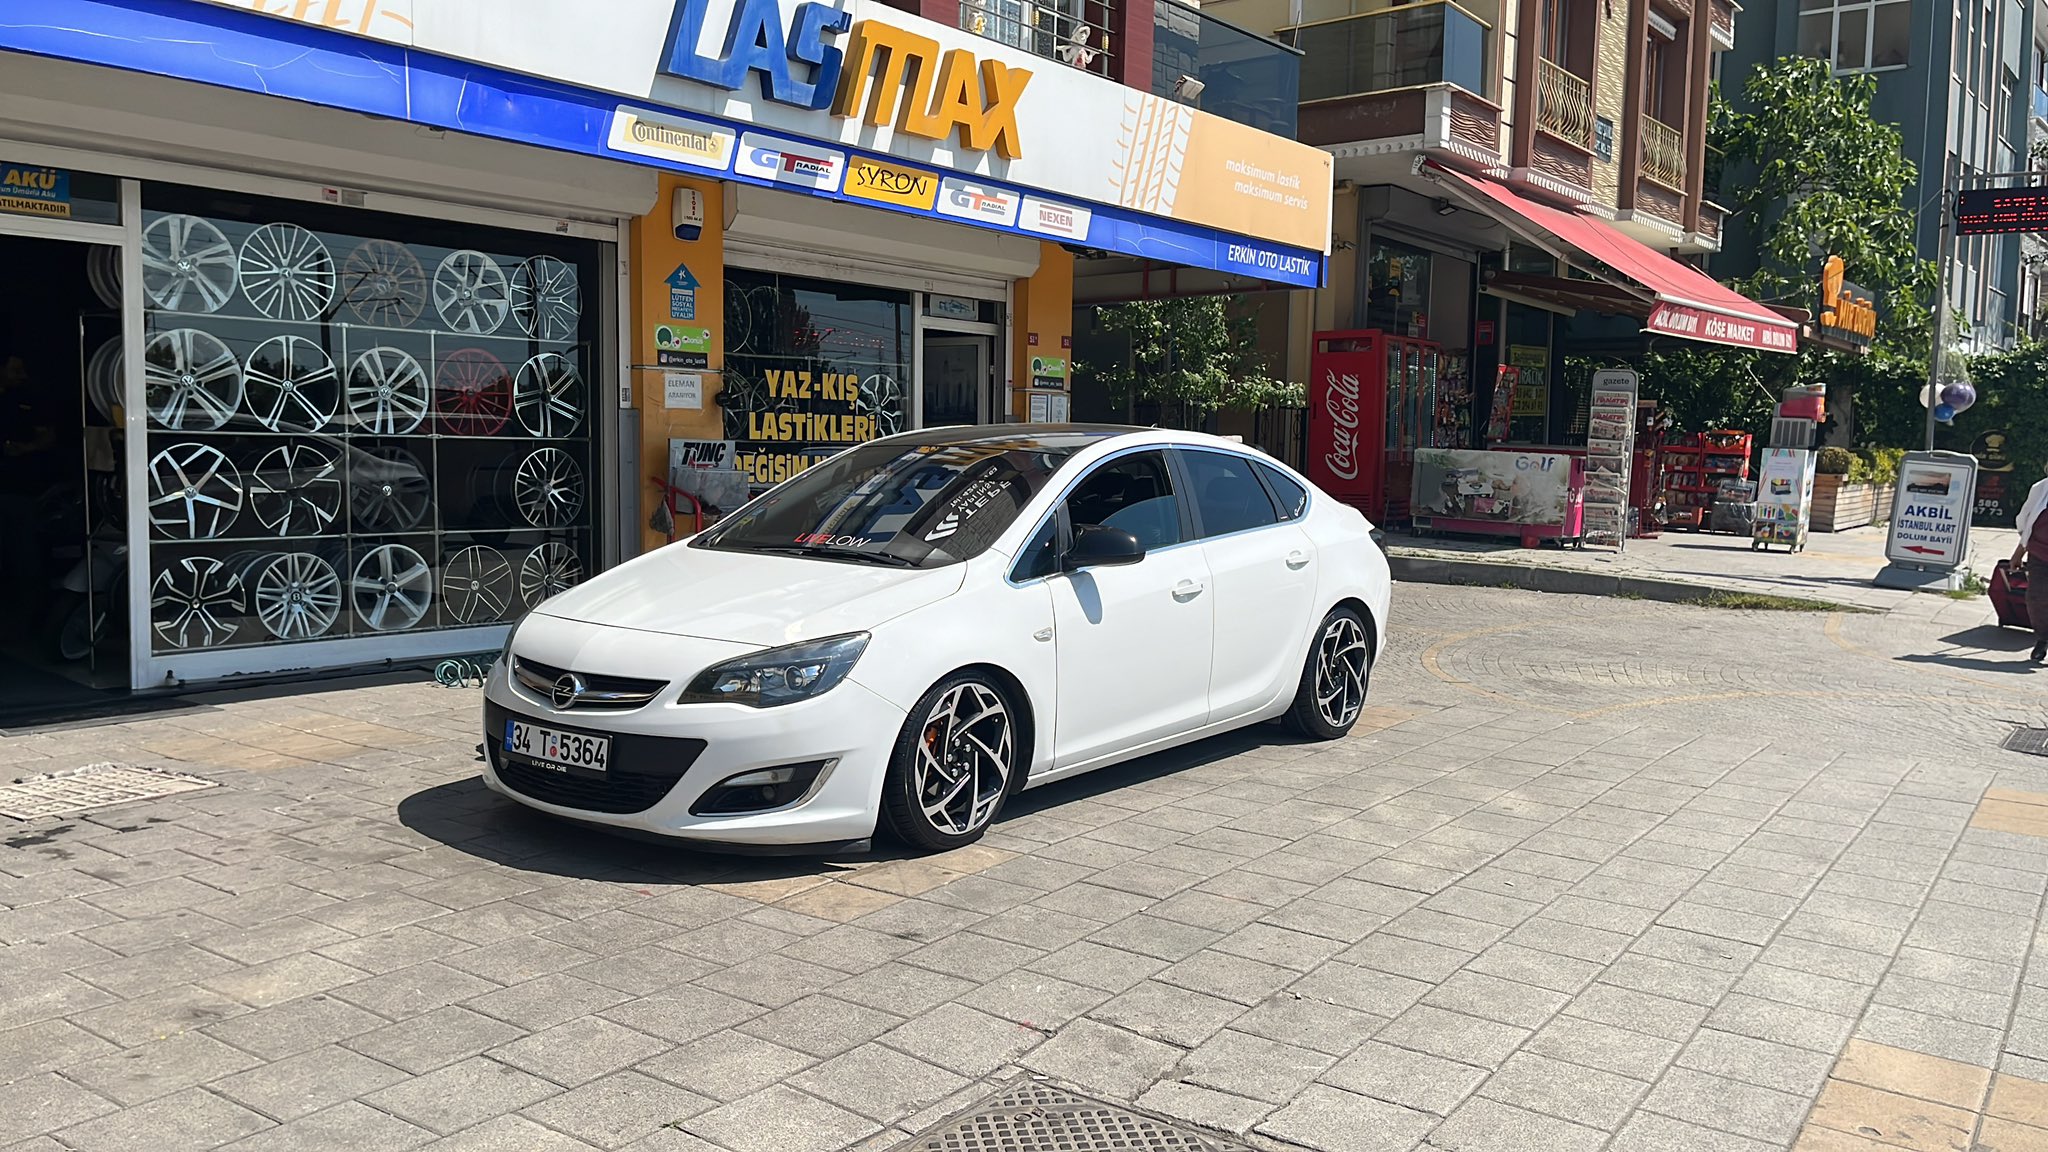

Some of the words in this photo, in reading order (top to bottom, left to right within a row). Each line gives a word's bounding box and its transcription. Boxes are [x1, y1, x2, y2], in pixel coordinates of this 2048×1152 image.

[655, 0, 1033, 160] LASMAX
[632, 121, 707, 152] Continental
[795, 161, 831, 174] RADIAL
[1226, 159, 1275, 180] maksimum
[1277, 171, 1300, 189] lastik
[4, 168, 56, 190] AKÜ
[857, 166, 927, 195] SYRON
[1234, 180, 1283, 202] maksimum
[1284, 195, 1308, 209] servis
[981, 202, 1006, 211] RADIAL
[1040, 209, 1073, 227] NEXEN
[1228, 244, 1255, 265] ERKİN
[1258, 250, 1278, 269] OTO
[1279, 255, 1311, 276] LASTİK
[672, 293, 693, 302] LÜTFEN
[672, 300, 693, 309] SOSYAL
[1705, 316, 1726, 338] KÖSE
[1726, 322, 1754, 342] MARKET
[668, 380, 695, 388] ELEMAN
[764, 369, 858, 410] YAZ-KIŞ
[1603, 377, 1630, 386] gazete
[681, 442, 727, 468] TUNÇ
[1515, 456, 1556, 473] Golf
[1904, 505, 1953, 520] AKBİL
[1989, 507, 2003, 516] 73
[1897, 517, 1933, 532] İSTANBUL
[1935, 523, 1957, 534] KART
[1897, 532, 1928, 541] DOLUM
[513, 724, 530, 752] 34
[539, 729, 551, 757] T
[560, 734, 605, 768] 5364
[531, 760, 545, 768] LIVE
[546, 763, 555, 771] OR
[556, 765, 567, 773] DIE
